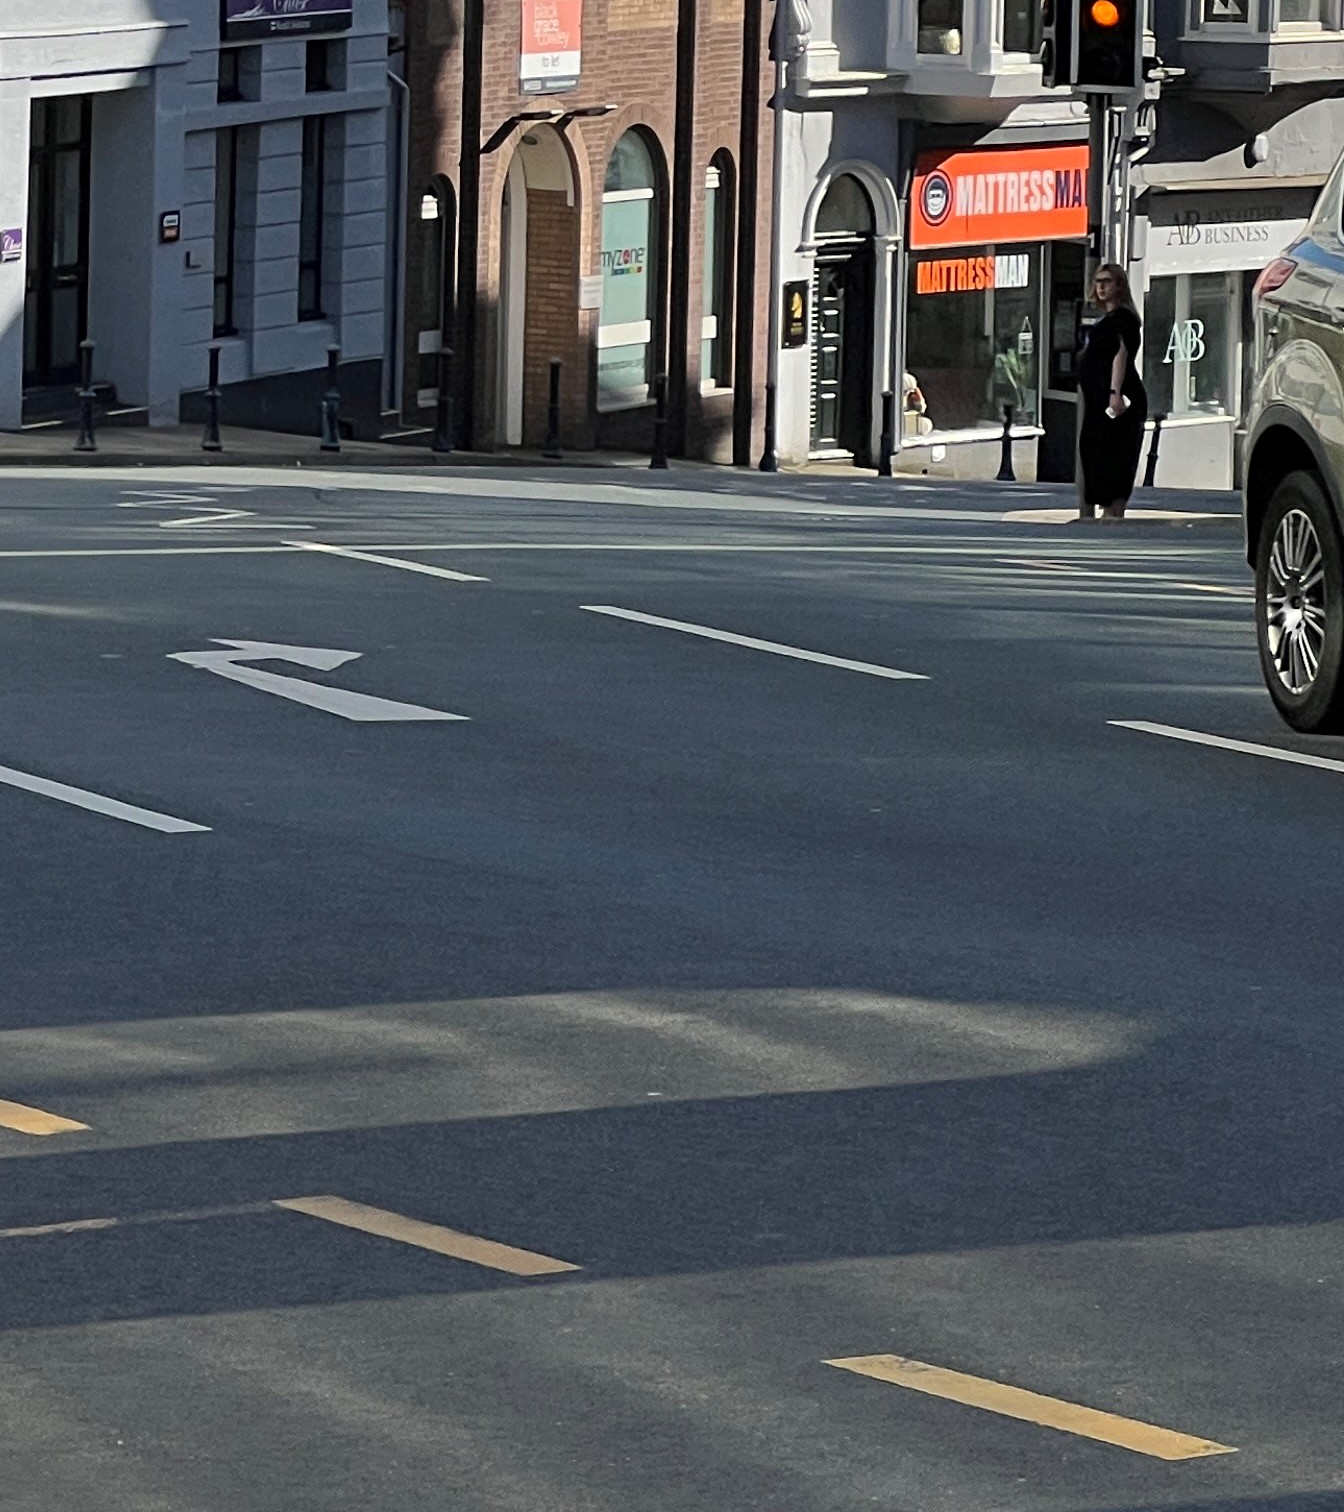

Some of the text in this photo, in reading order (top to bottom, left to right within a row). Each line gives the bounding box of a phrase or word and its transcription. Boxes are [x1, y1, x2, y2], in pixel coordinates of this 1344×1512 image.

[955, 168, 1089, 217] MATTRESSMA
[1205, 225, 1269, 244] BUSINESS
[917, 254, 1029, 294] MATTRESSMAN
